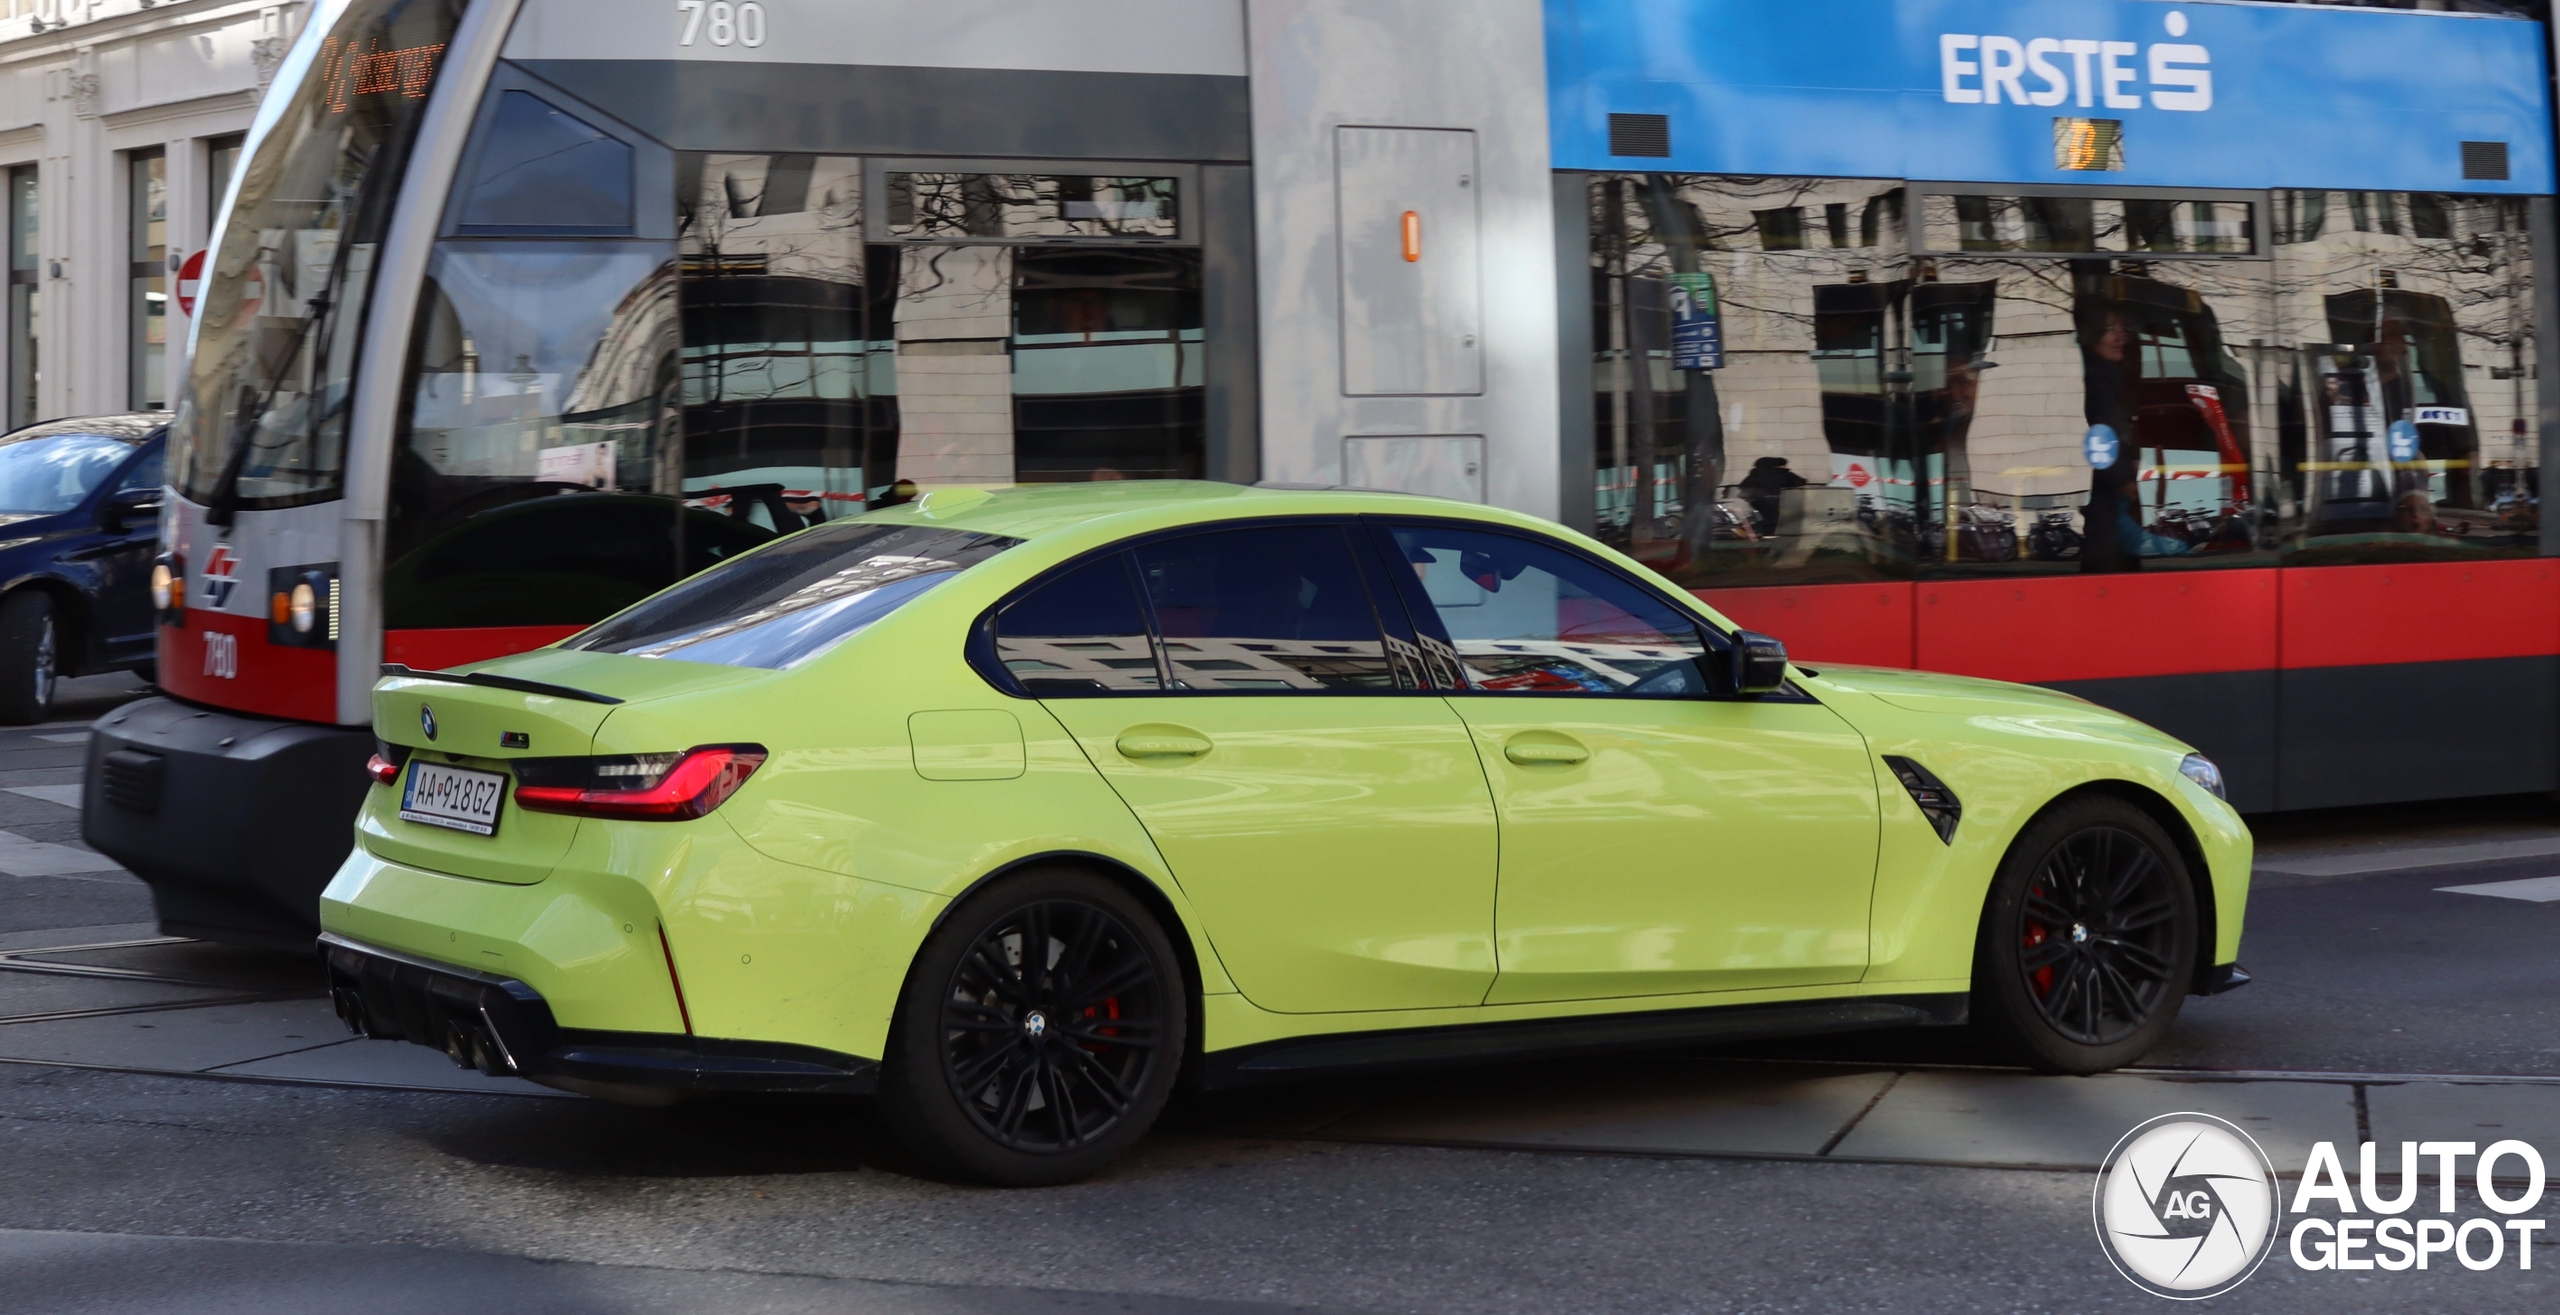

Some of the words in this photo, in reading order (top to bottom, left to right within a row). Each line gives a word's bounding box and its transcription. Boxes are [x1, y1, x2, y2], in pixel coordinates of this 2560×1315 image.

[677, 1, 767, 47] 780
[1939, 33, 2142, 109] ERSTE
[203, 631, 238, 679] 780
